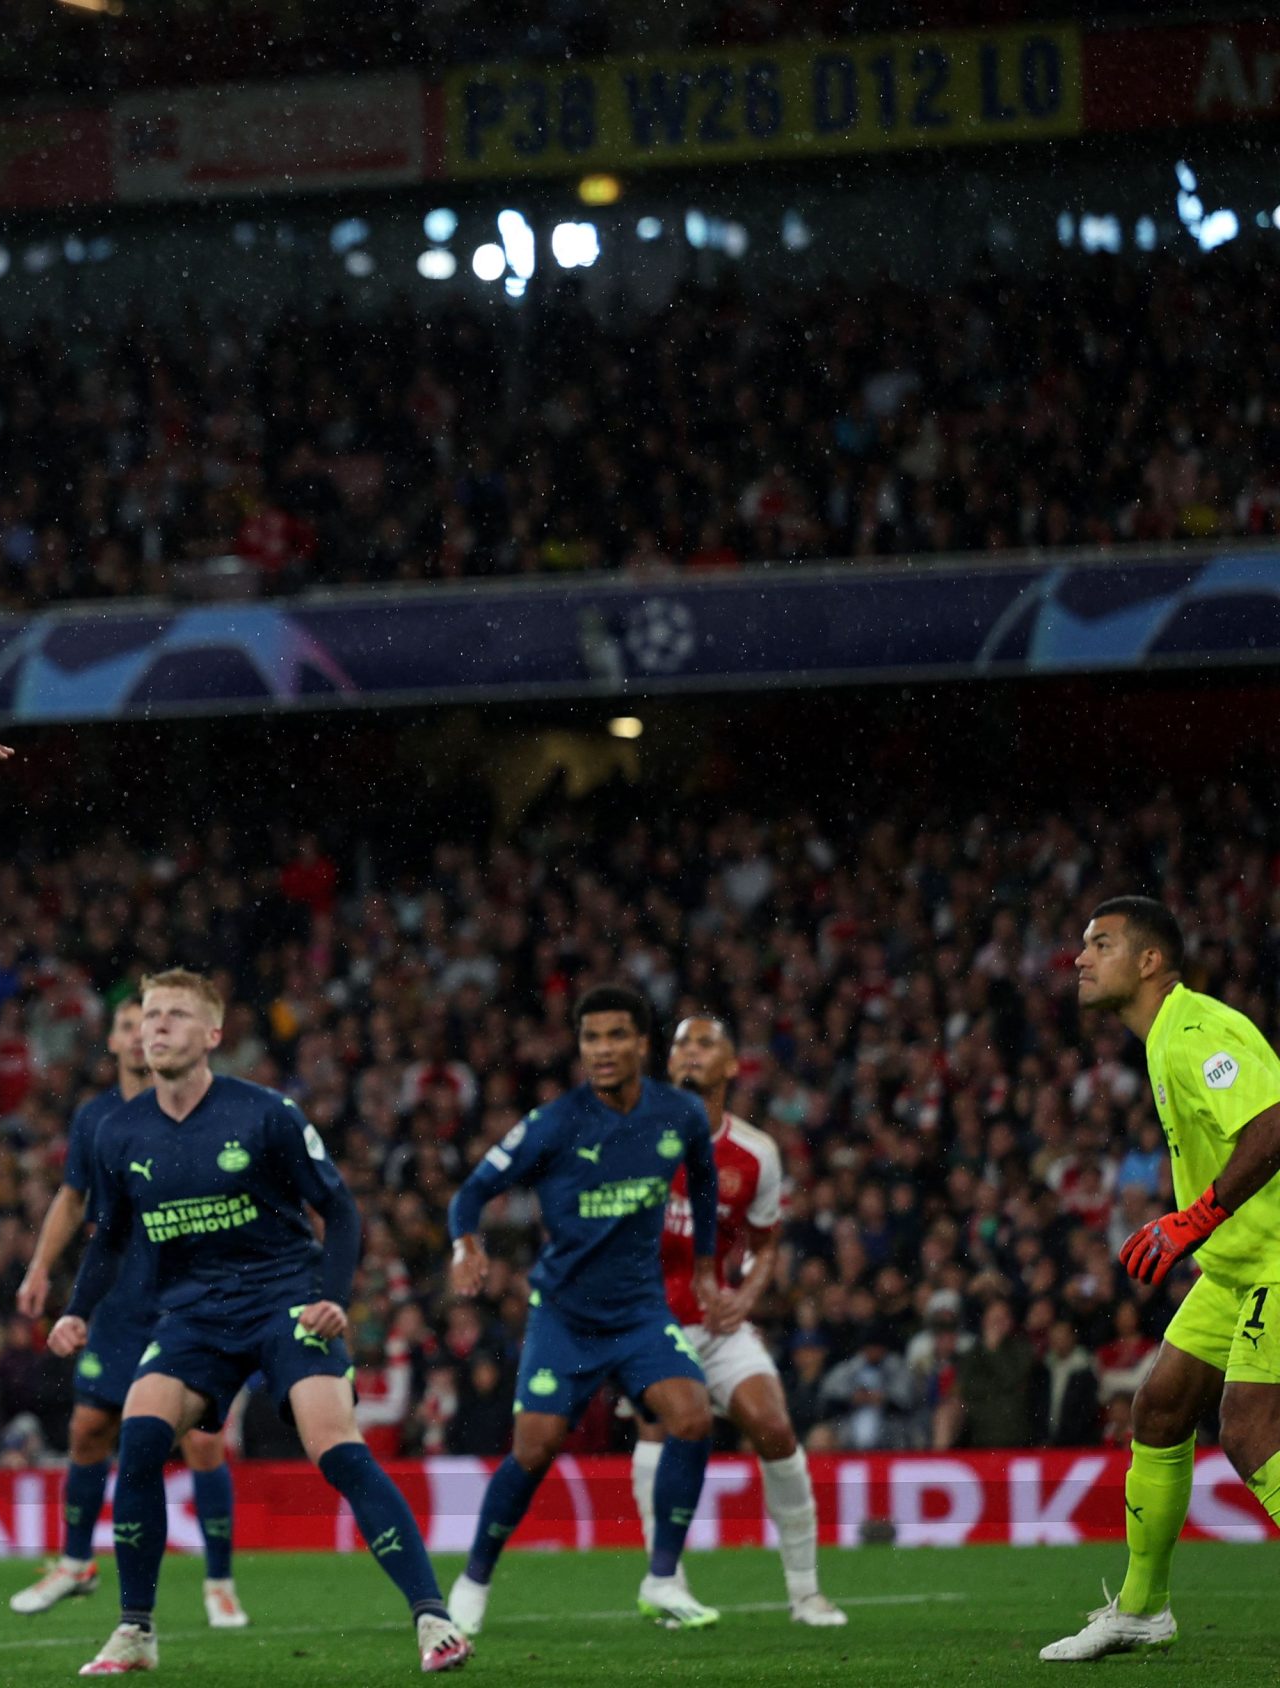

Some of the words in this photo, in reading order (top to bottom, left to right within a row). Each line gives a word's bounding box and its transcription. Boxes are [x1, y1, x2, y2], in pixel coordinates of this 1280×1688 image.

[466, 76, 595, 160] P38
[812, 48, 953, 135] D12
[1206, 1060, 1233, 1083] TOTO
[141, 1193, 252, 1228] BRAINPORT
[146, 1204, 259, 1243] EINDHOVEN
[1246, 1287, 1269, 1329] 1
